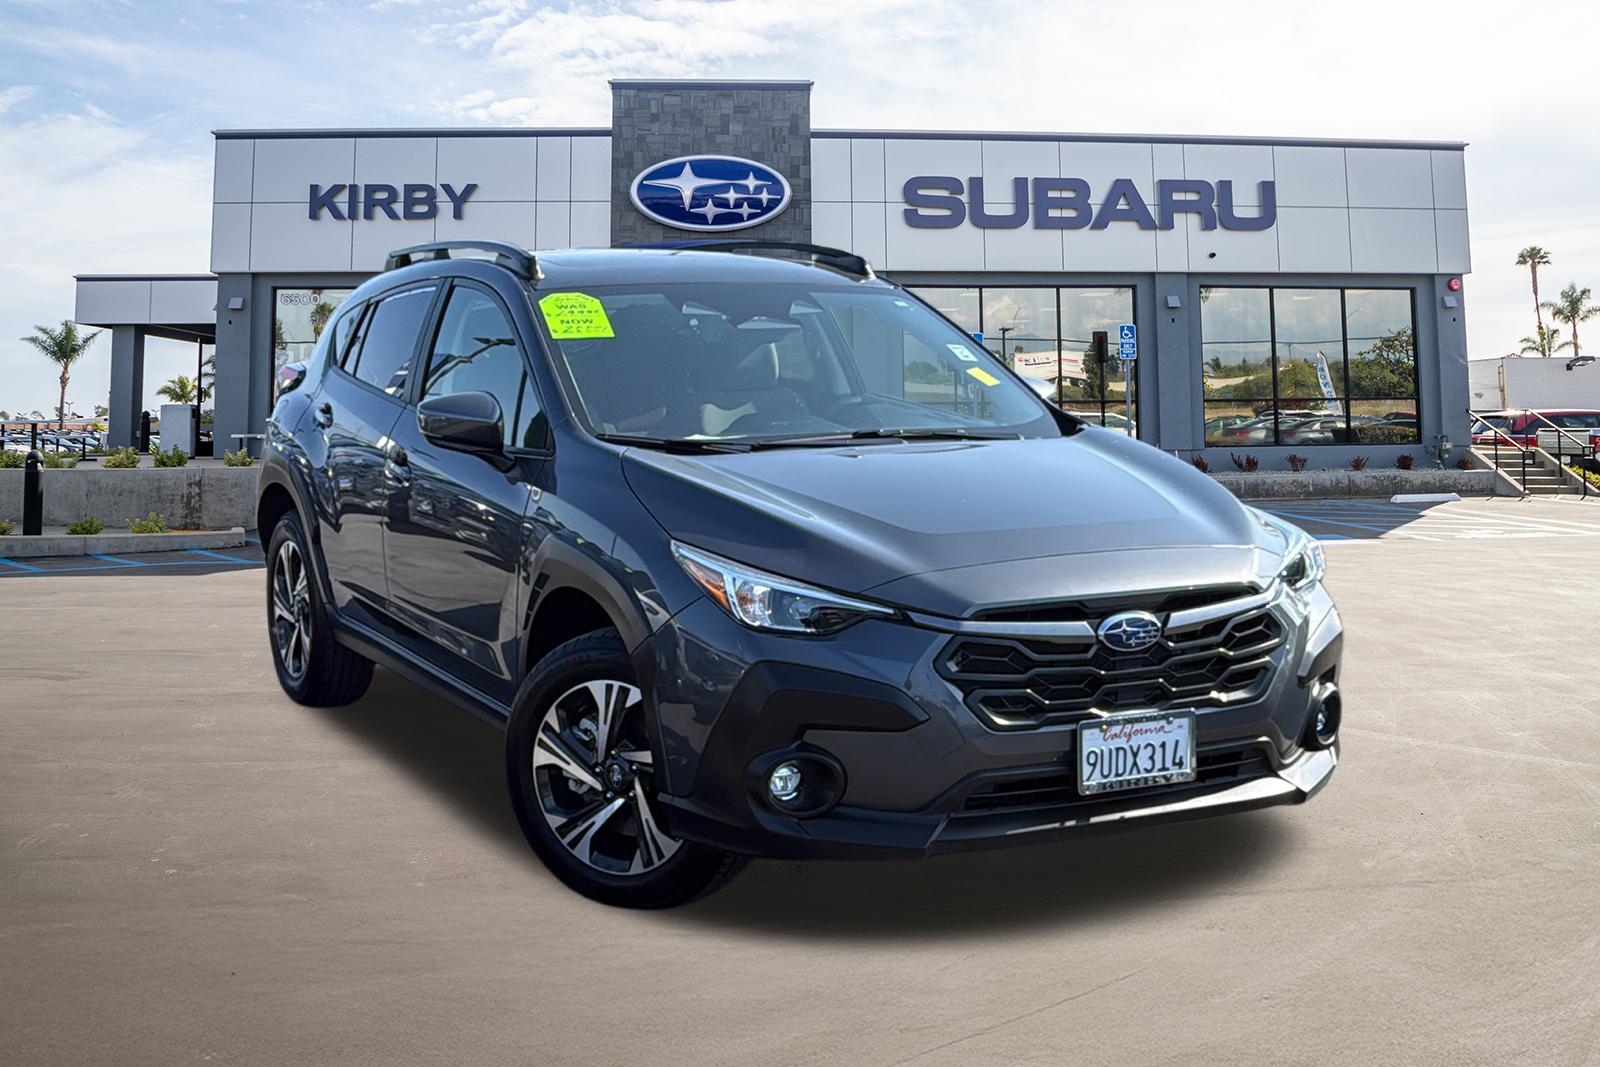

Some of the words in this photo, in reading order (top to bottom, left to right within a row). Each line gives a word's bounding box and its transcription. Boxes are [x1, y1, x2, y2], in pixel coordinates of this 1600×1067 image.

[308, 183, 479, 220] KIRBY
[903, 176, 1277, 231] SUBARU
[1101, 723, 1173, 743] California
[1086, 739, 1184, 782] 9UDX314
